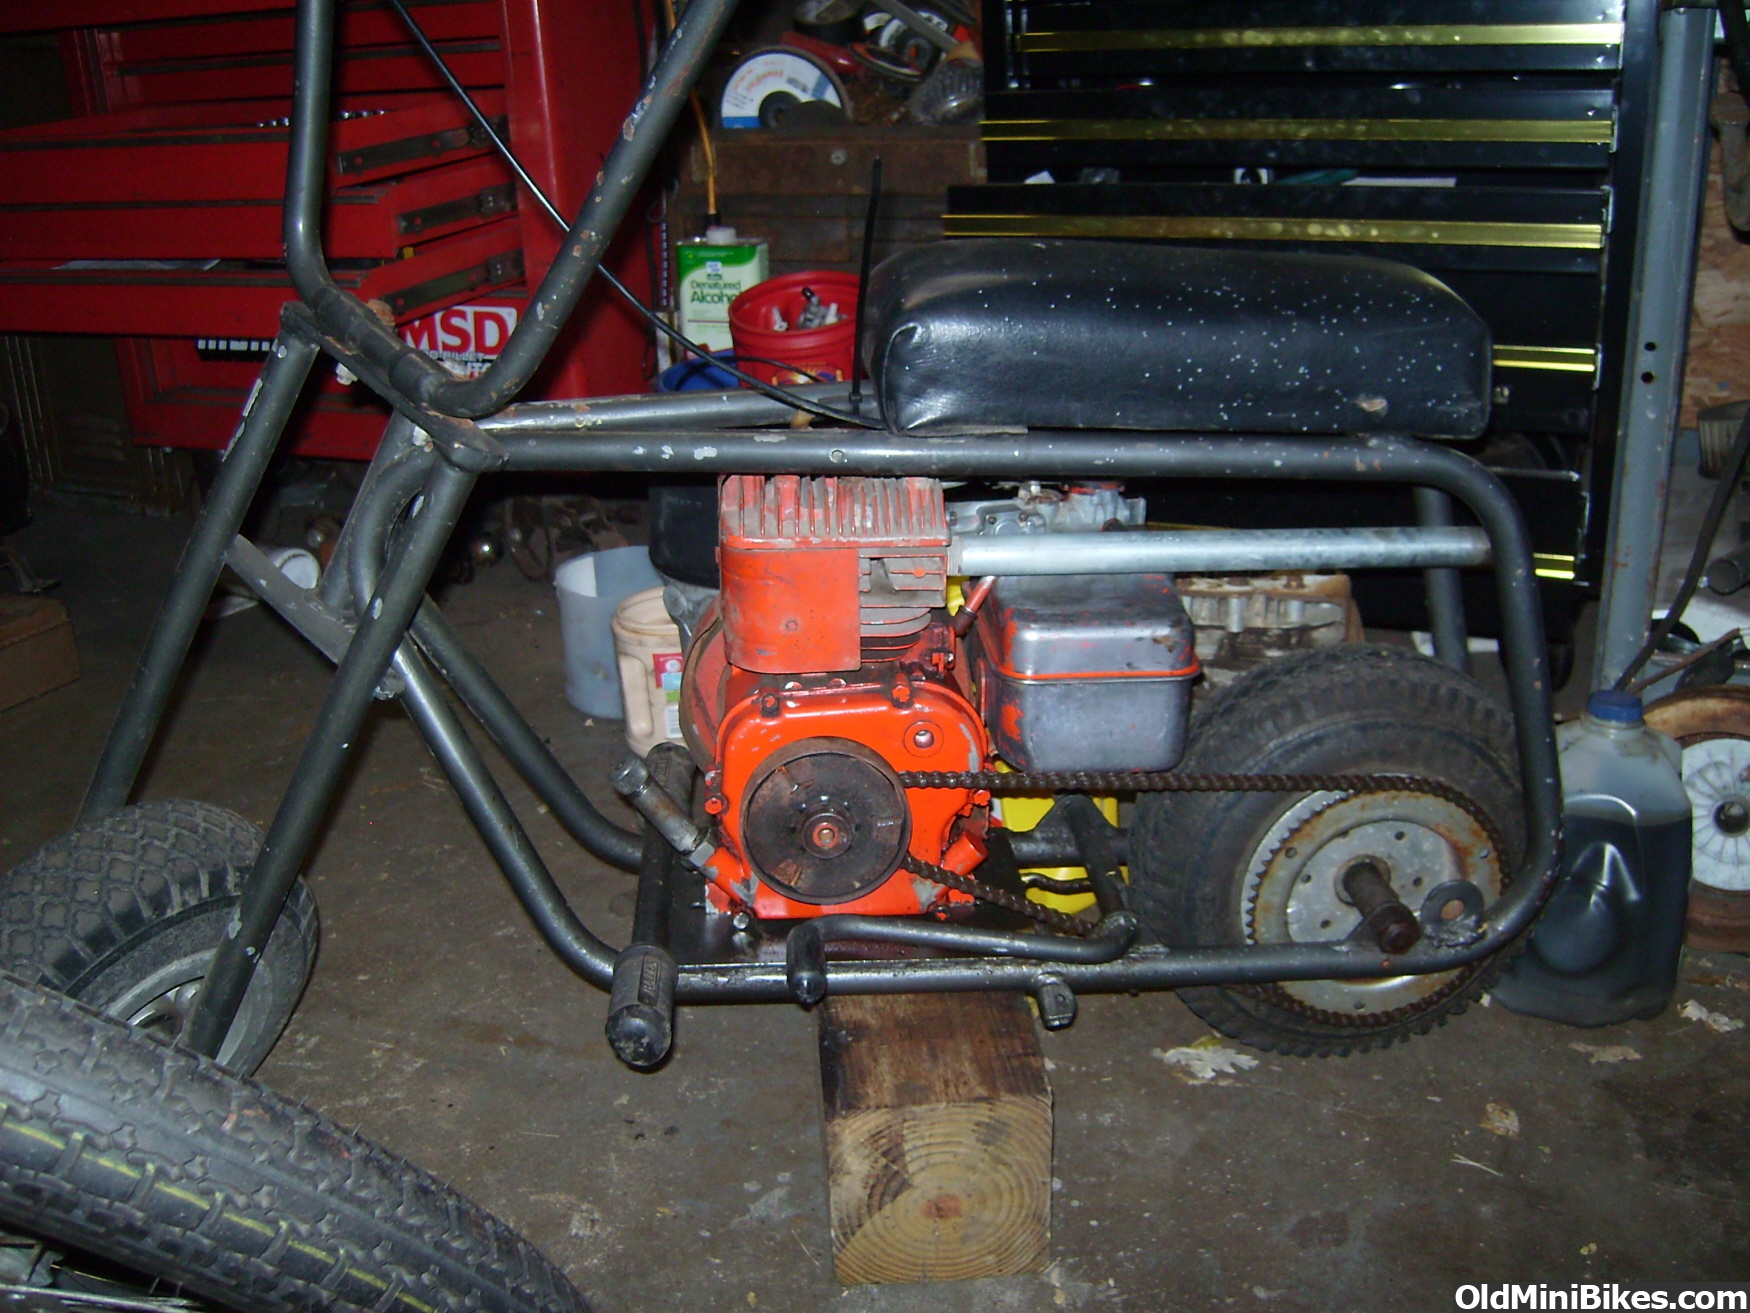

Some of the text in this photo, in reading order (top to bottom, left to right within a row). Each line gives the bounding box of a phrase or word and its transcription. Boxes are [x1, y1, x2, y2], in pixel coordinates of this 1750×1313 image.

[690, 280, 742, 291] Denatured
[690, 289, 743, 304] Alcoho
[398, 308, 511, 356] MSD
